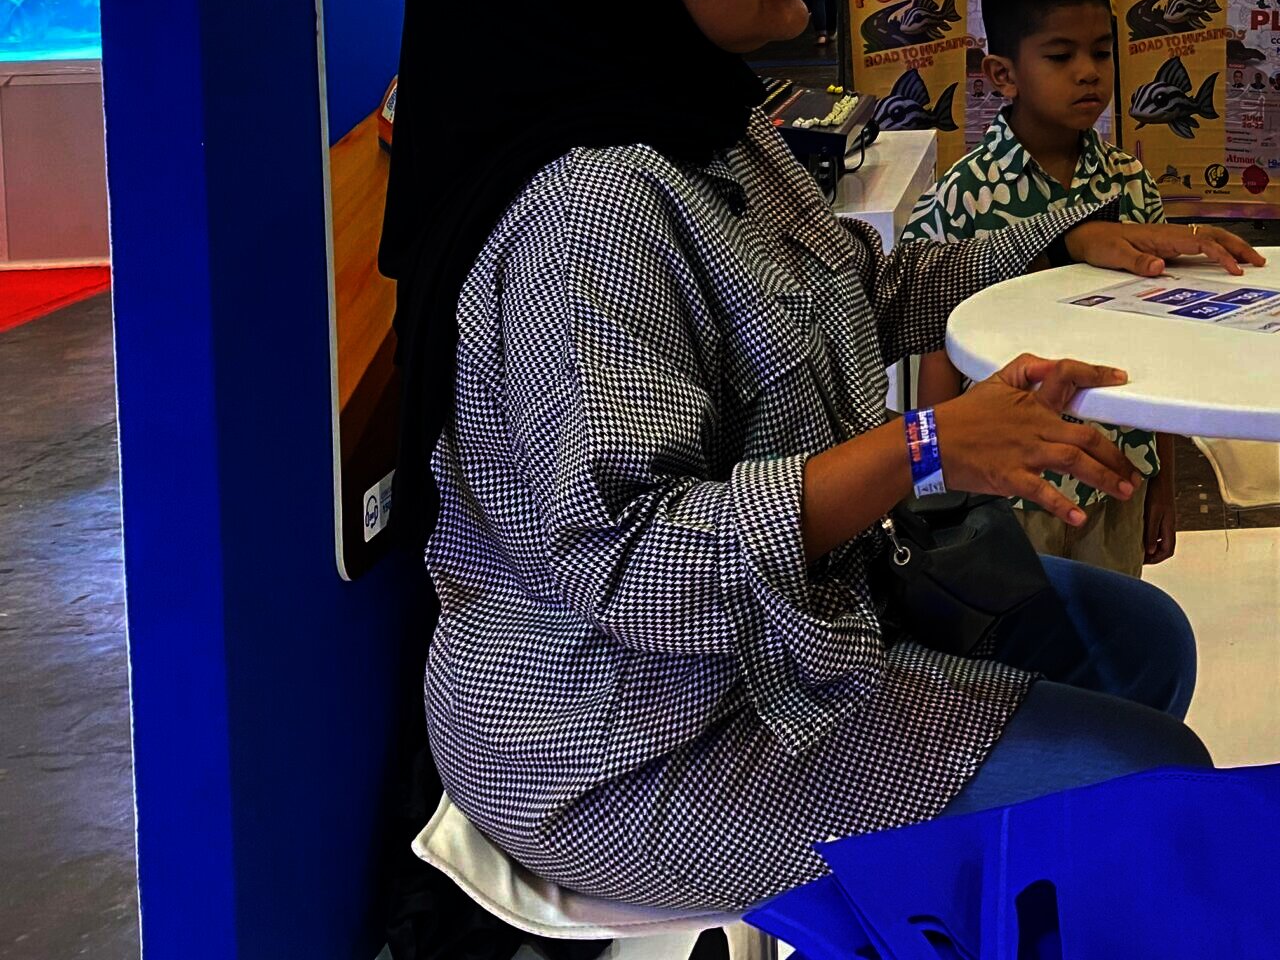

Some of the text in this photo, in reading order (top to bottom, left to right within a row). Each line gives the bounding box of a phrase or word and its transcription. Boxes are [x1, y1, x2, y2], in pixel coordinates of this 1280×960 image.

[864, 37, 966, 68] ROAD TO NUSATI
[1128, 28, 1227, 56] ROAD TO NUSATI
[1226, 154, 1255, 164] Atman
